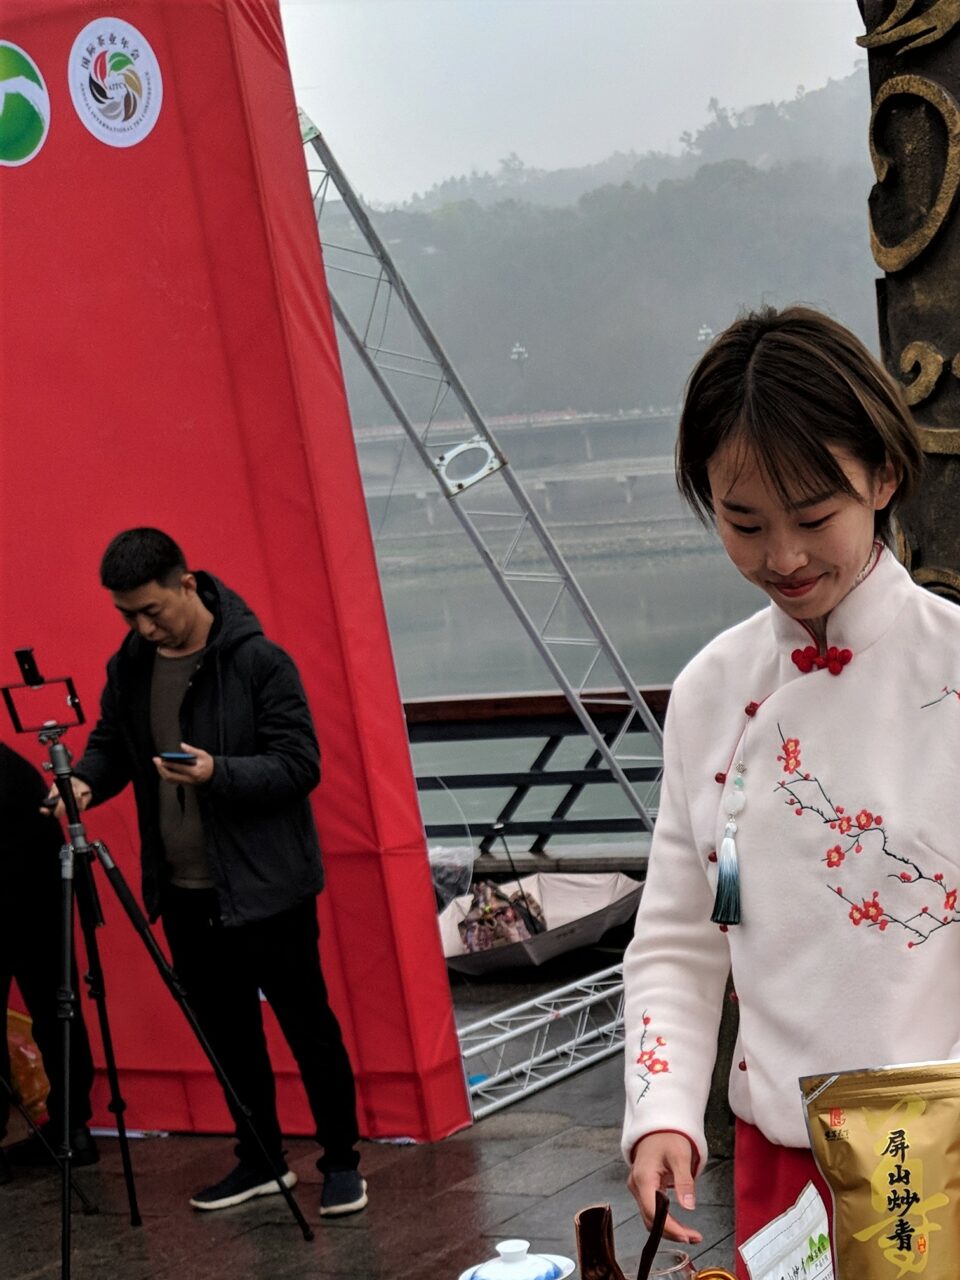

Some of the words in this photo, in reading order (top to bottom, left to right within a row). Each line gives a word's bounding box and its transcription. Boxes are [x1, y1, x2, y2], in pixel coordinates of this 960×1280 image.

[81, 32, 140, 70] 国际茶业年会
[881, 1129, 921, 1251] 屏山炒青
